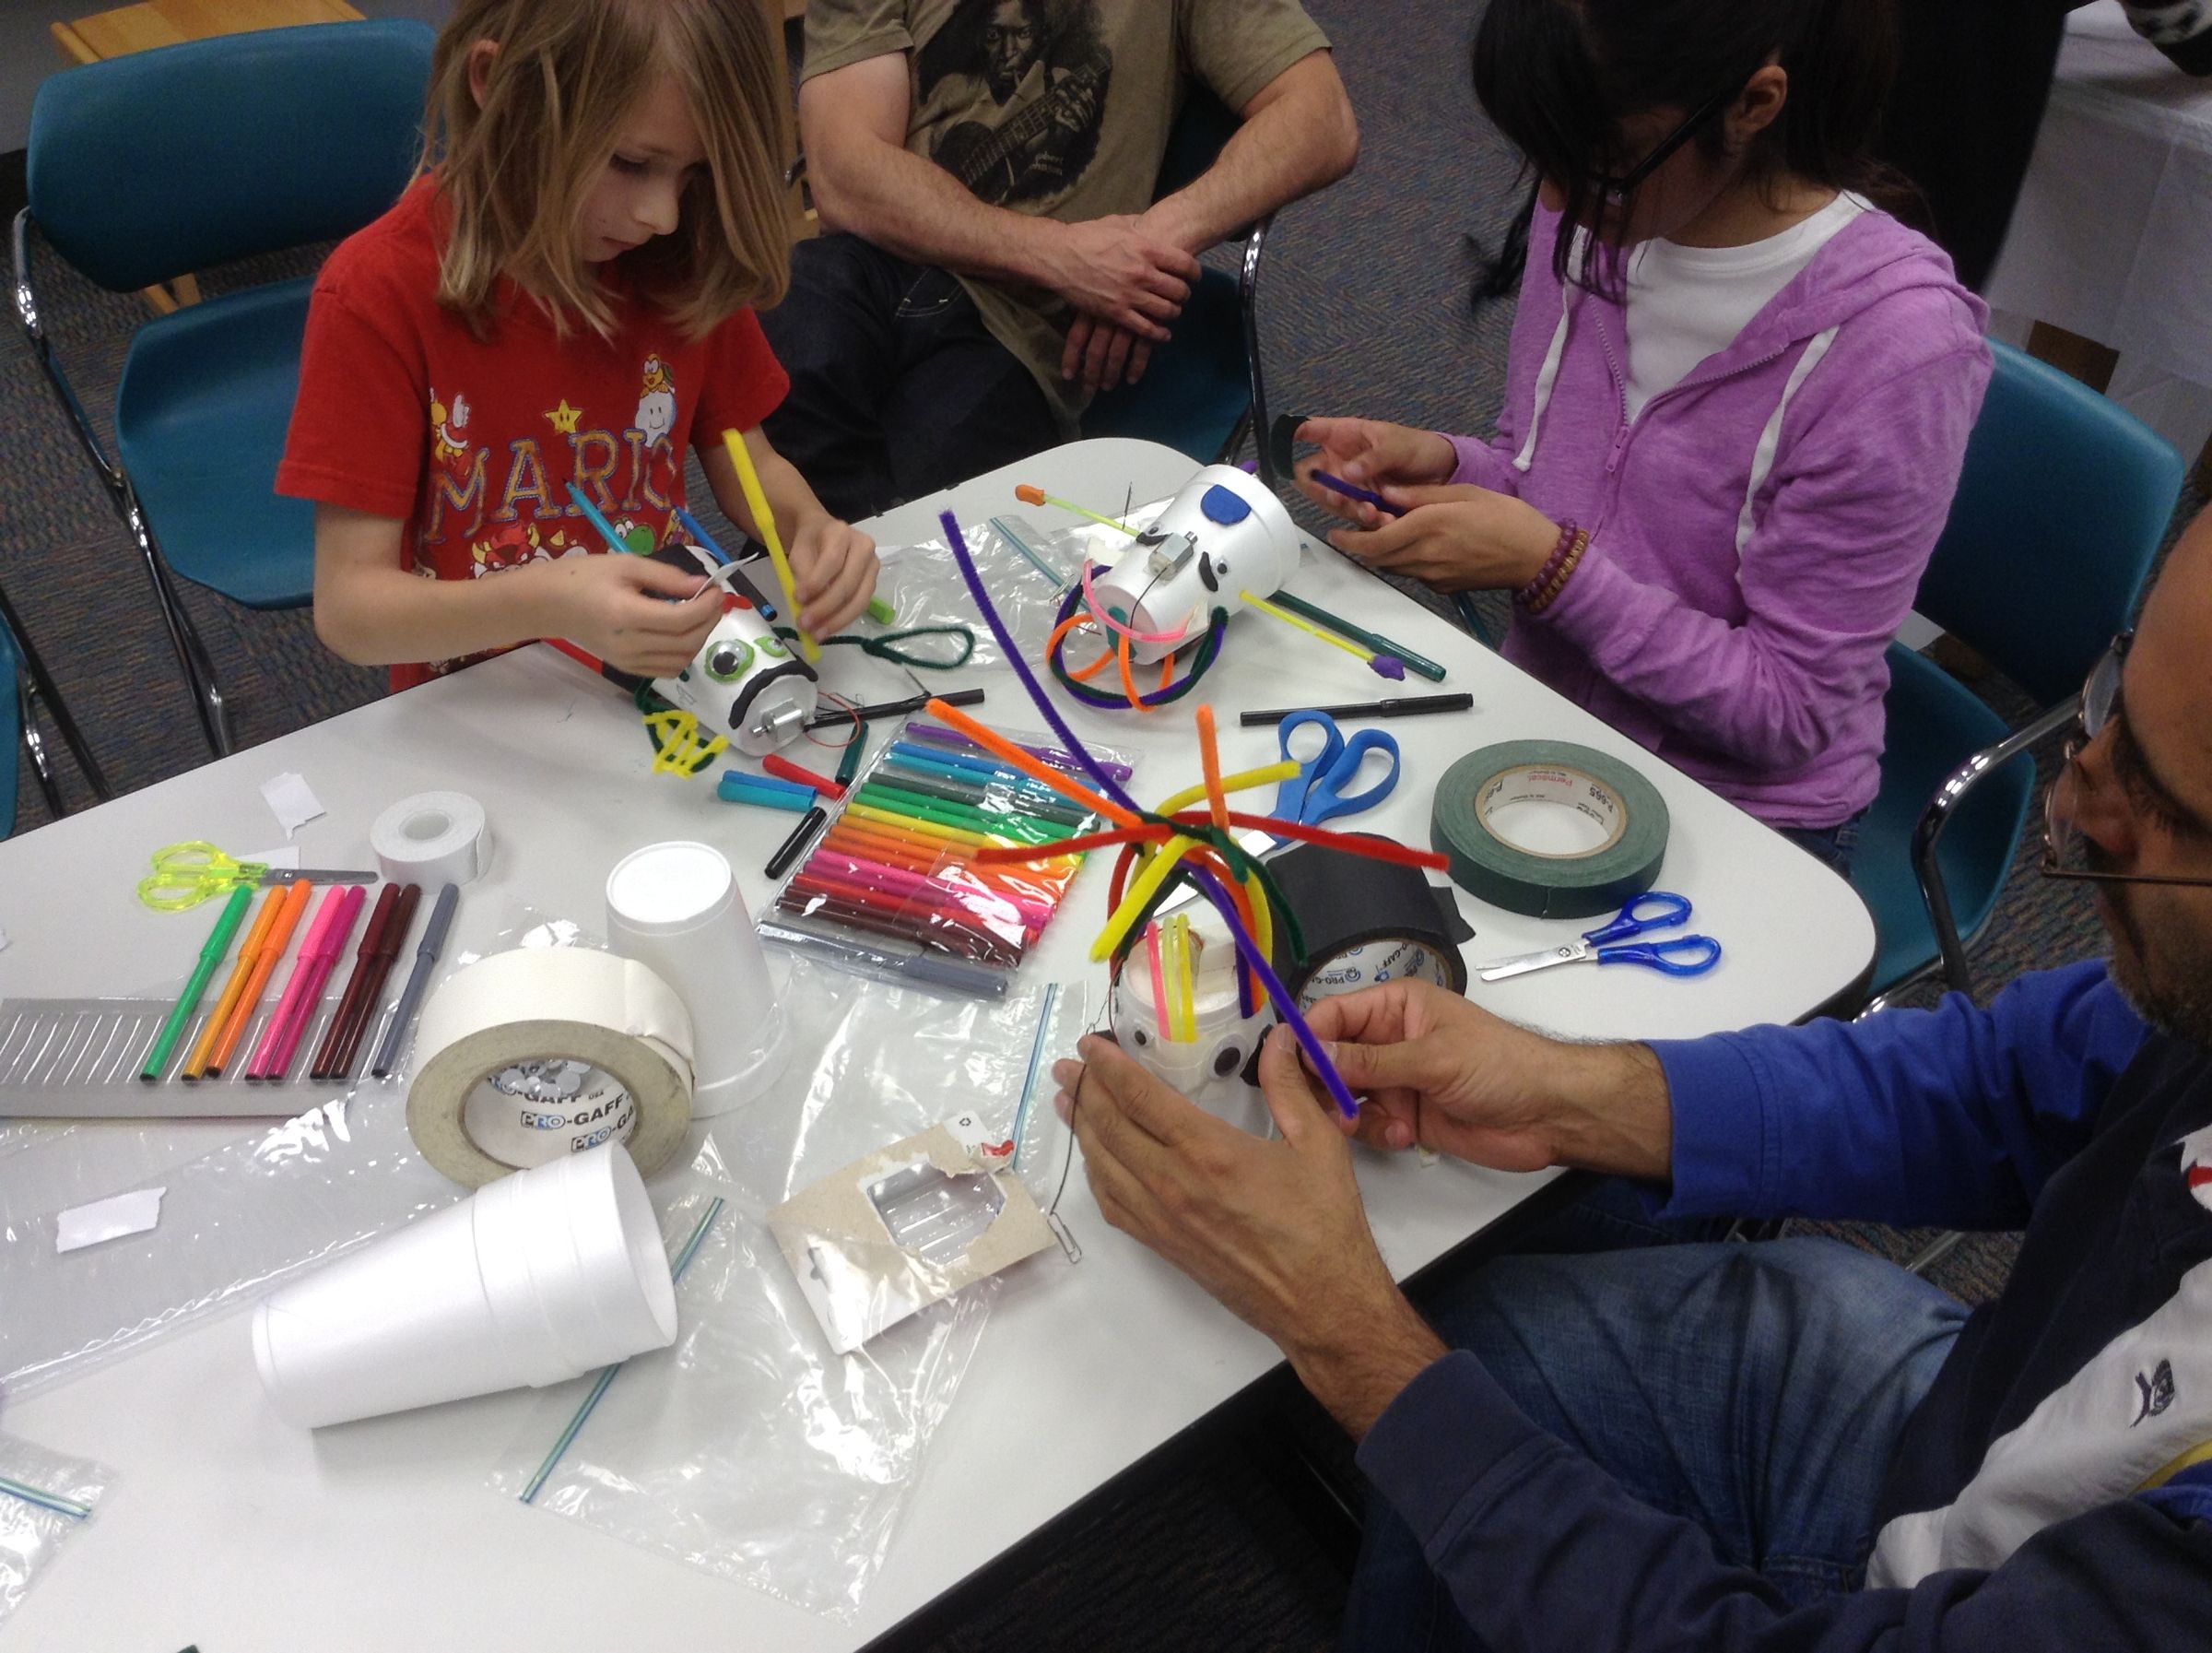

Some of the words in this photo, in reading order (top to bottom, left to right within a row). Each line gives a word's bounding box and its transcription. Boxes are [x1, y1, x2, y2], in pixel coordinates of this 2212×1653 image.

[425, 428, 677, 545] MARIO
[1590, 786, 1614, 813] P-665
[521, 1093, 624, 1130] PRO-GAFF
